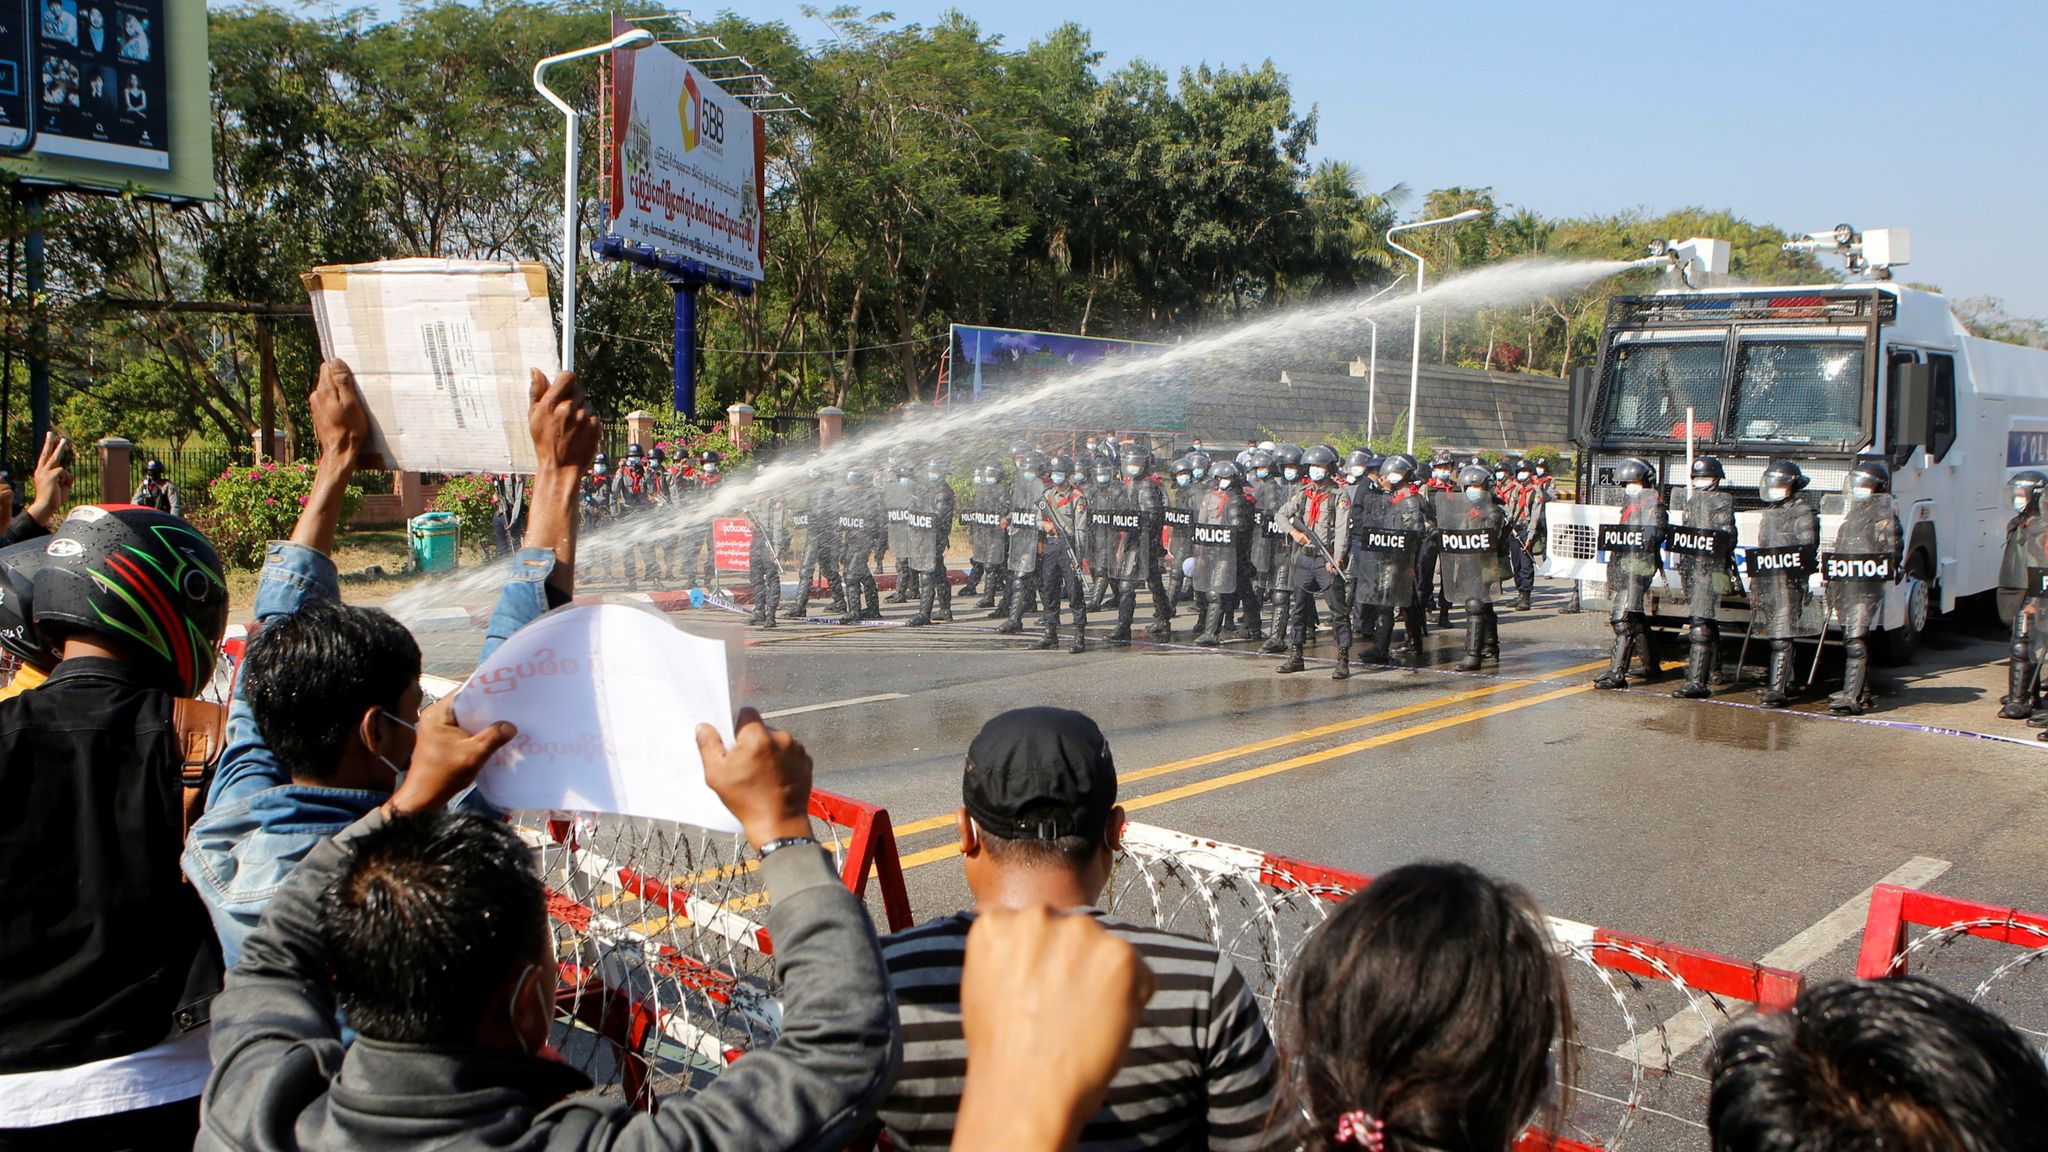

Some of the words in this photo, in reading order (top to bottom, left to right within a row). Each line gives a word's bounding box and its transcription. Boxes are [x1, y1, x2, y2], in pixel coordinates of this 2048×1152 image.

[701, 97, 724, 144] 5BB
[2020, 434, 2048, 464] POL
[839, 516, 864, 528] POLICE
[888, 510, 909, 521] POLIC
[961, 512, 976, 522] POLIC
[1092, 513, 1110, 524] POLI
[1113, 514, 1139, 527] POLICE
[1165, 511, 1190, 524] POLICE
[1194, 527, 1232, 543] POLICE
[1369, 533, 1405, 548] POLICE
[1442, 533, 1490, 550] POLICE
[1604, 531, 1643, 546] POLICE
[1673, 532, 1714, 551] POLICE
[1757, 552, 1801, 570] POLICE
[1827, 559, 1889, 577] POLICE
